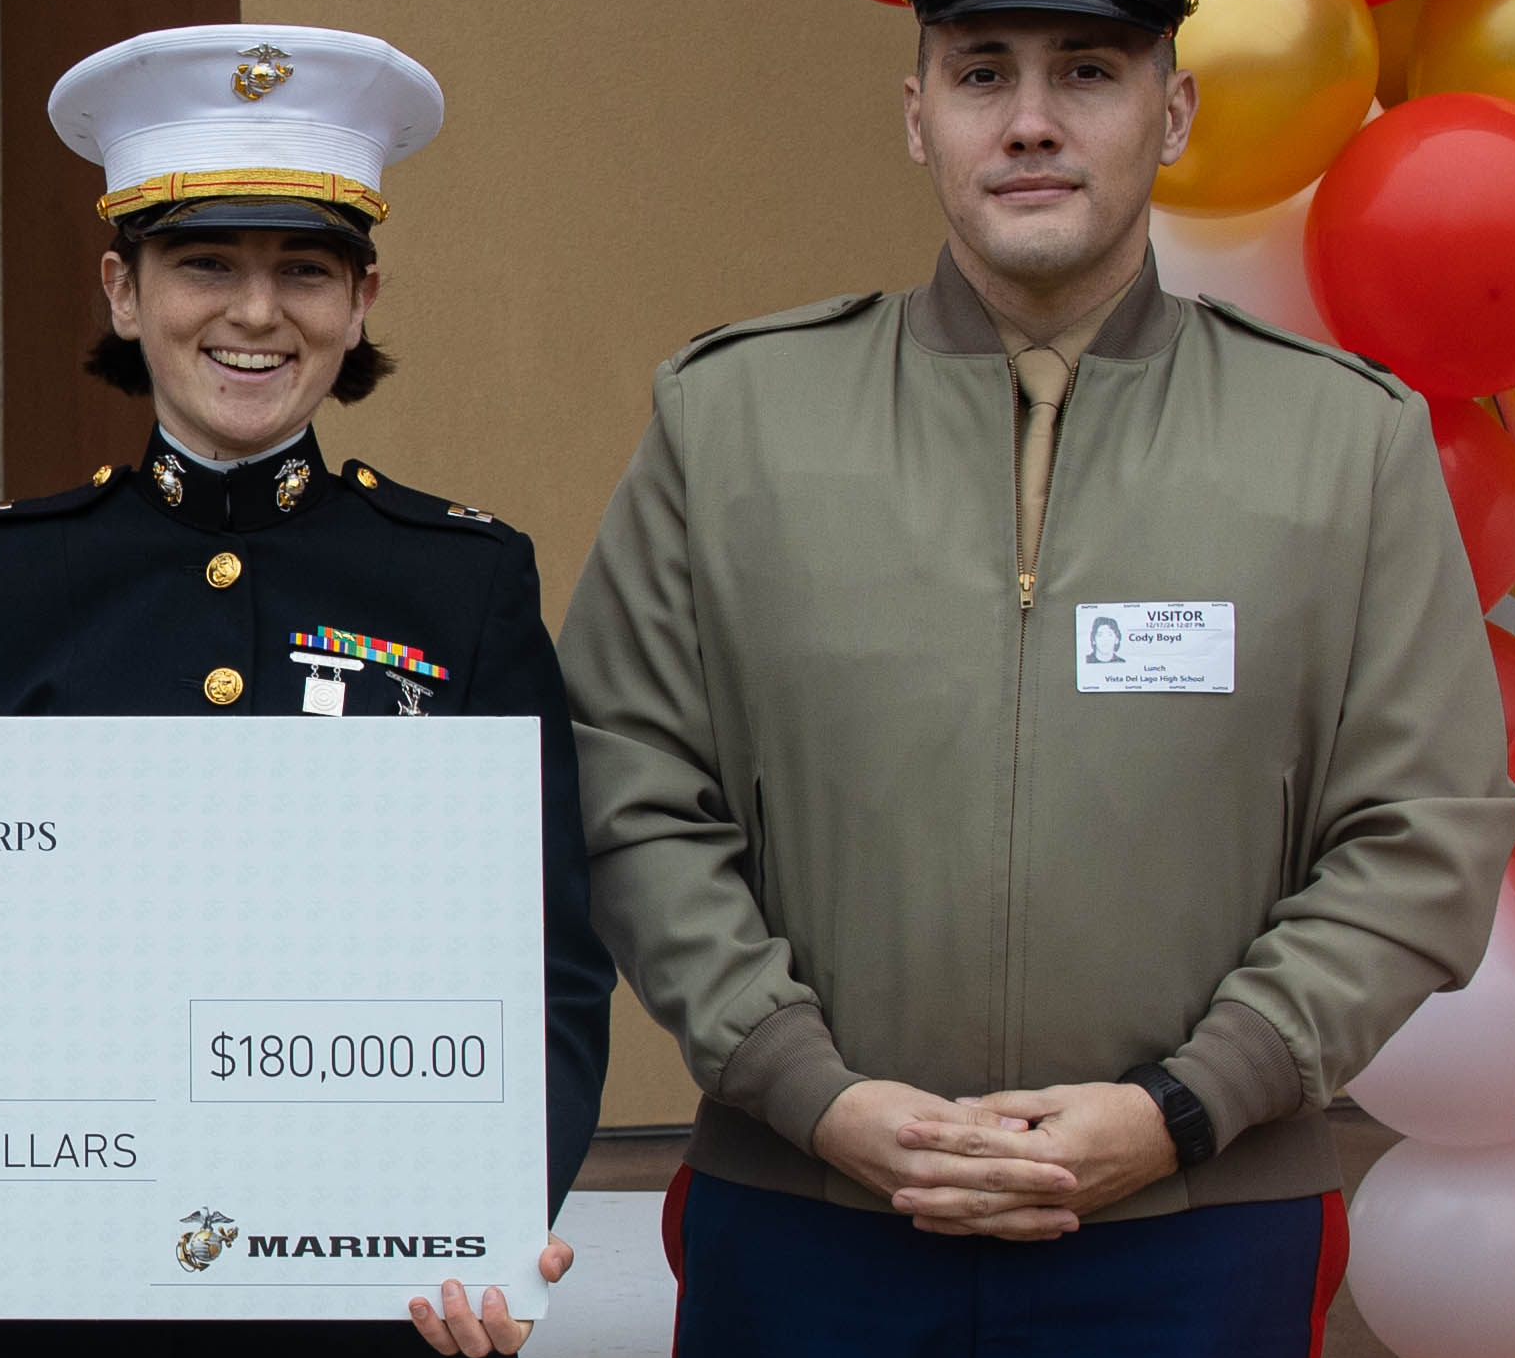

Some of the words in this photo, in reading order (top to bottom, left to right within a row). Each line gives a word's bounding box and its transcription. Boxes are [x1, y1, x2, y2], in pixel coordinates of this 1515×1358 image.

[1146, 610, 1204, 622] VISITOR
[1128, 632, 1154, 644] Cody
[1156, 632, 1182, 644] Boyd
[1104, 675, 1124, 683] Vista
[1125, 675, 1138, 683] Del
[1140, 675, 1158, 684] Lago
[1159, 675, 1178, 684] High
[1179, 675, 1205, 683] School
[210, 1031, 485, 1083] $180,000.00
[247, 1235, 487, 1258] MARINES
